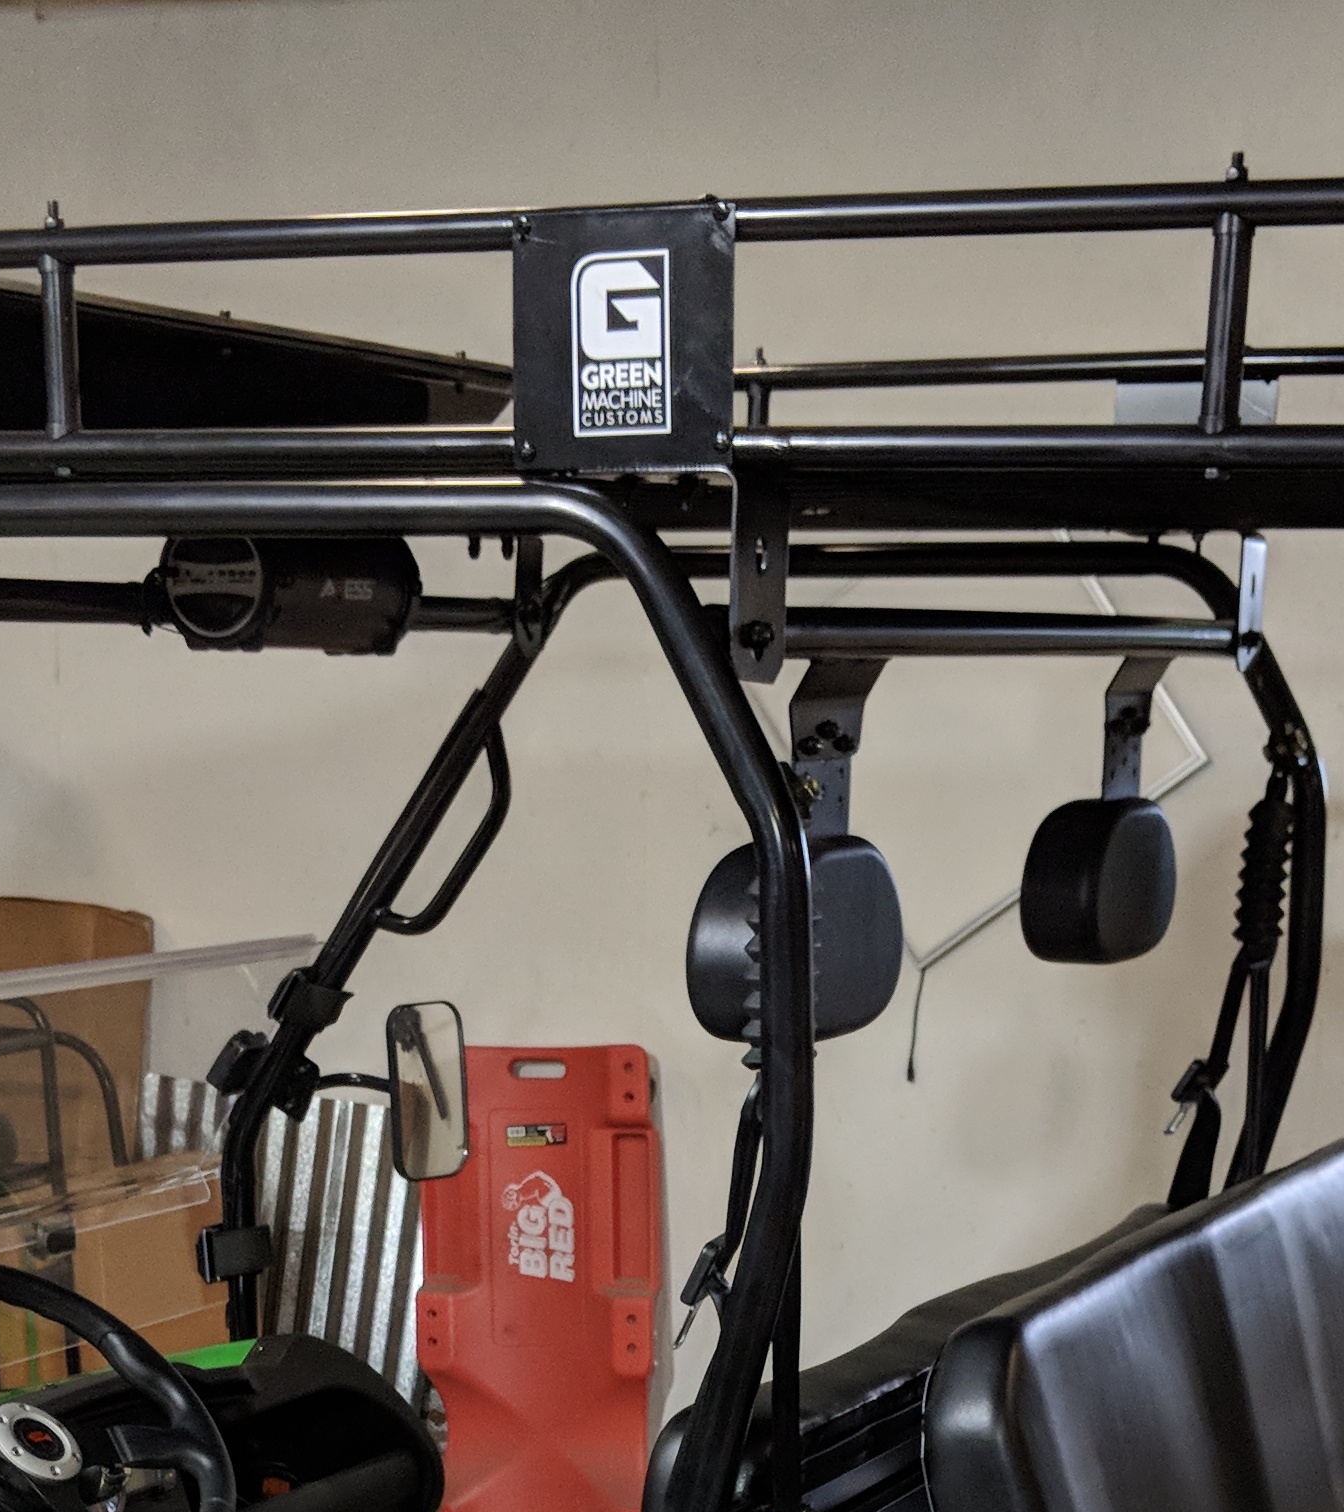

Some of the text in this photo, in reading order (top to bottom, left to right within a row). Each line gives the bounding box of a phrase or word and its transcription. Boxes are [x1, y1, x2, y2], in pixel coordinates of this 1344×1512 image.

[581, 361, 662, 388] GREEN
[581, 389, 662, 411] MACHINE
[581, 410, 663, 427] CUSTOMS
[518, 1206, 547, 1277] BIG
[549, 1198, 574, 1282] RED
